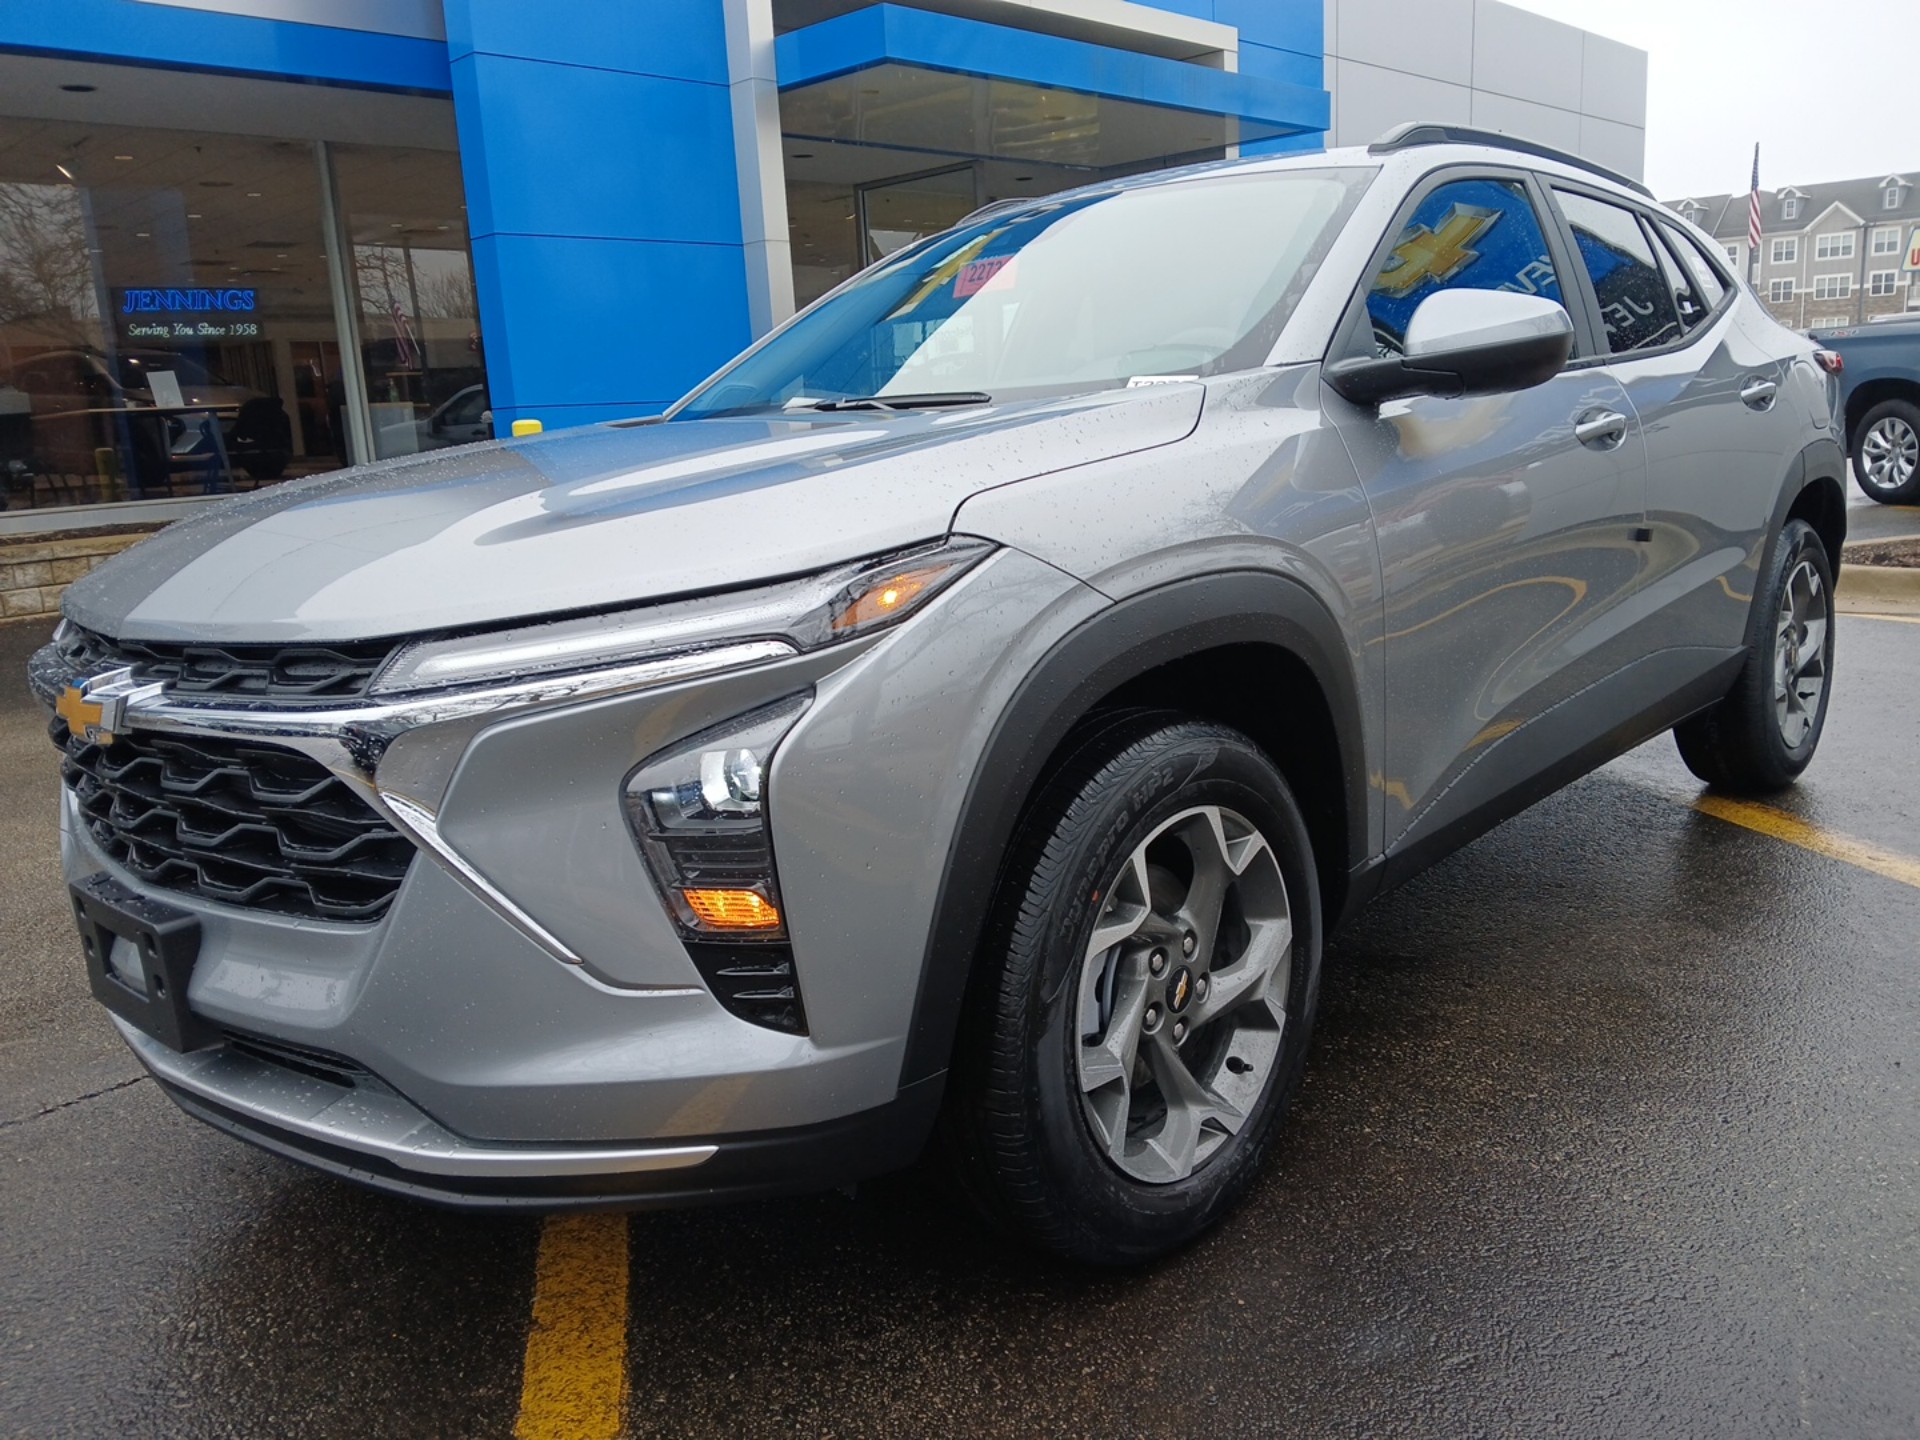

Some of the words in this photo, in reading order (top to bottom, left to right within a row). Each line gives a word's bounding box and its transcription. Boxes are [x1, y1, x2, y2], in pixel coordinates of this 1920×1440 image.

[123, 289, 256, 314] JENNINGS
[128, 322, 170, 338] Serving
[172, 322, 194, 336] You
[196, 321, 226, 336] Since
[229, 323, 258, 336] 1958
[1132, 766, 1175, 813] HP2
